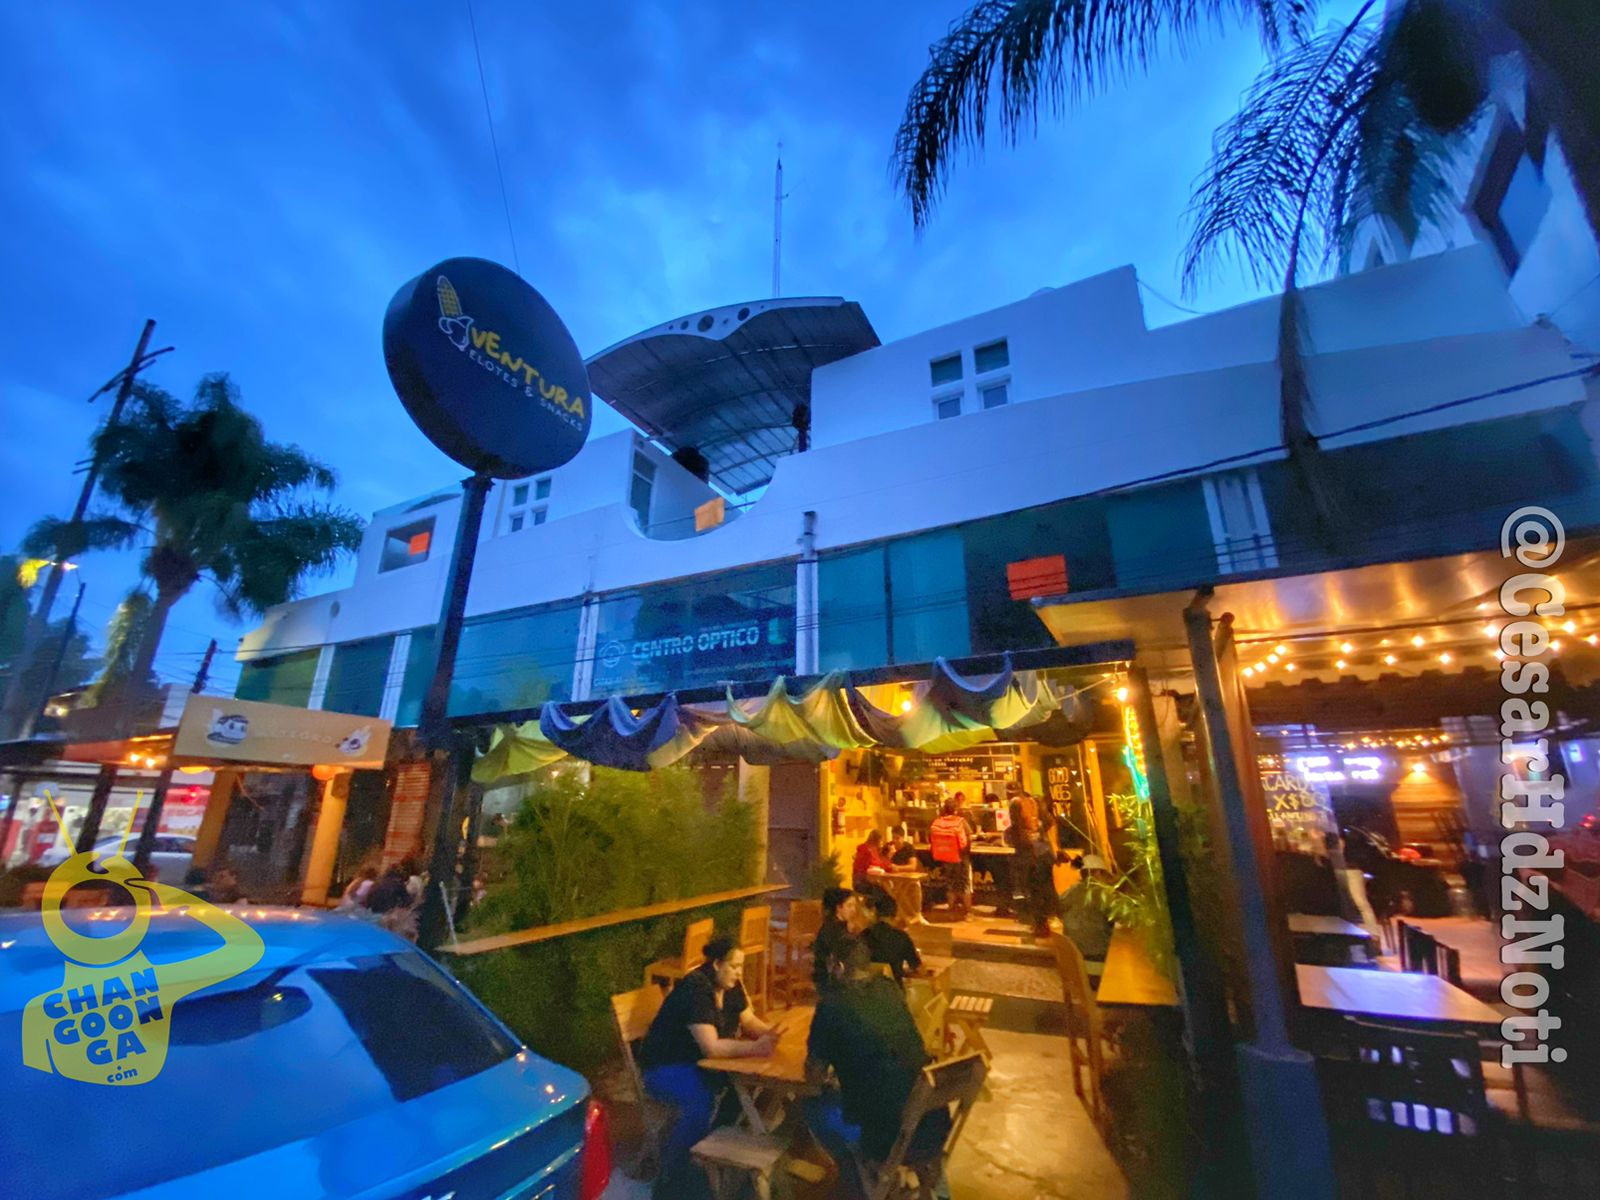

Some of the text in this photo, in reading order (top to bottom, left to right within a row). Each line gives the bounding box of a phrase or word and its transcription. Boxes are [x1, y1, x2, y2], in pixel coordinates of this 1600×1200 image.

[469, 349, 518, 388] ELOTES
[540, 398, 583, 432] SNACKS
[471, 327, 585, 419] VENTURA
[631, 636, 694, 660] CENTRO
[697, 626, 760, 651] OPTICO
